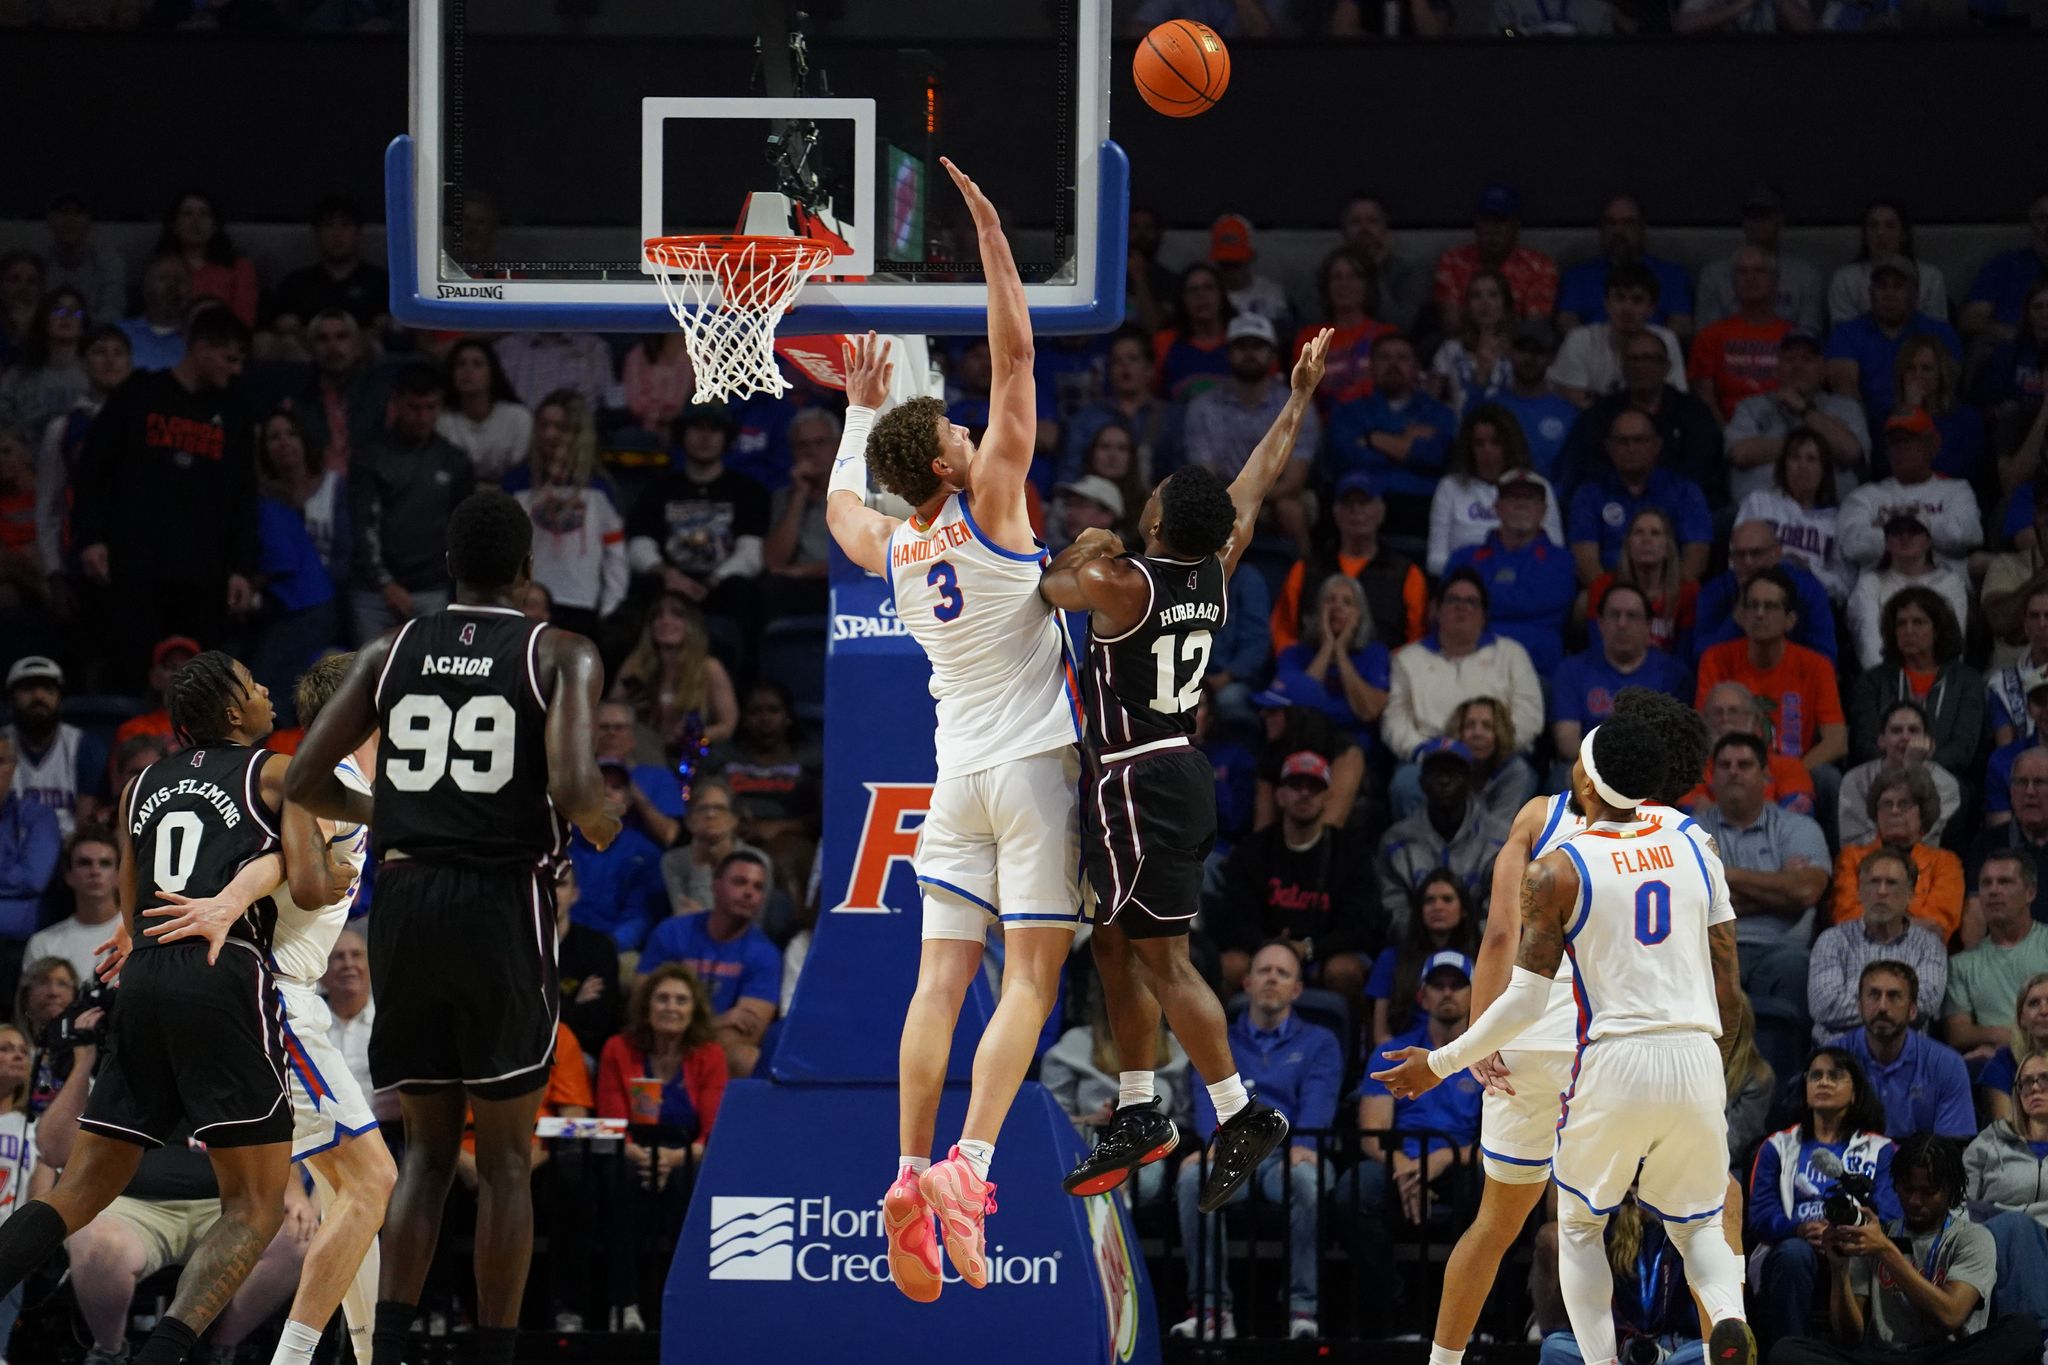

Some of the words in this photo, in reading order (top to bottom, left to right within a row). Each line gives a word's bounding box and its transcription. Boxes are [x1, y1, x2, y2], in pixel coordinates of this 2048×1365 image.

[437, 284, 503, 300] SPALDING
[927, 559, 964, 623] 3
[1159, 602, 1220, 628] HUBBARD
[832, 613, 914, 641] SPALD
[421, 654, 494, 678] ACHOR
[1149, 629, 1213, 715] 12
[385, 693, 517, 794] 99
[132, 778, 241, 838] DAVIS-FLEMING
[153, 811, 205, 893] 0
[1611, 845, 1674, 875] FLAND
[1634, 879, 1671, 947] 0
[800, 1194, 884, 1238] Flori
